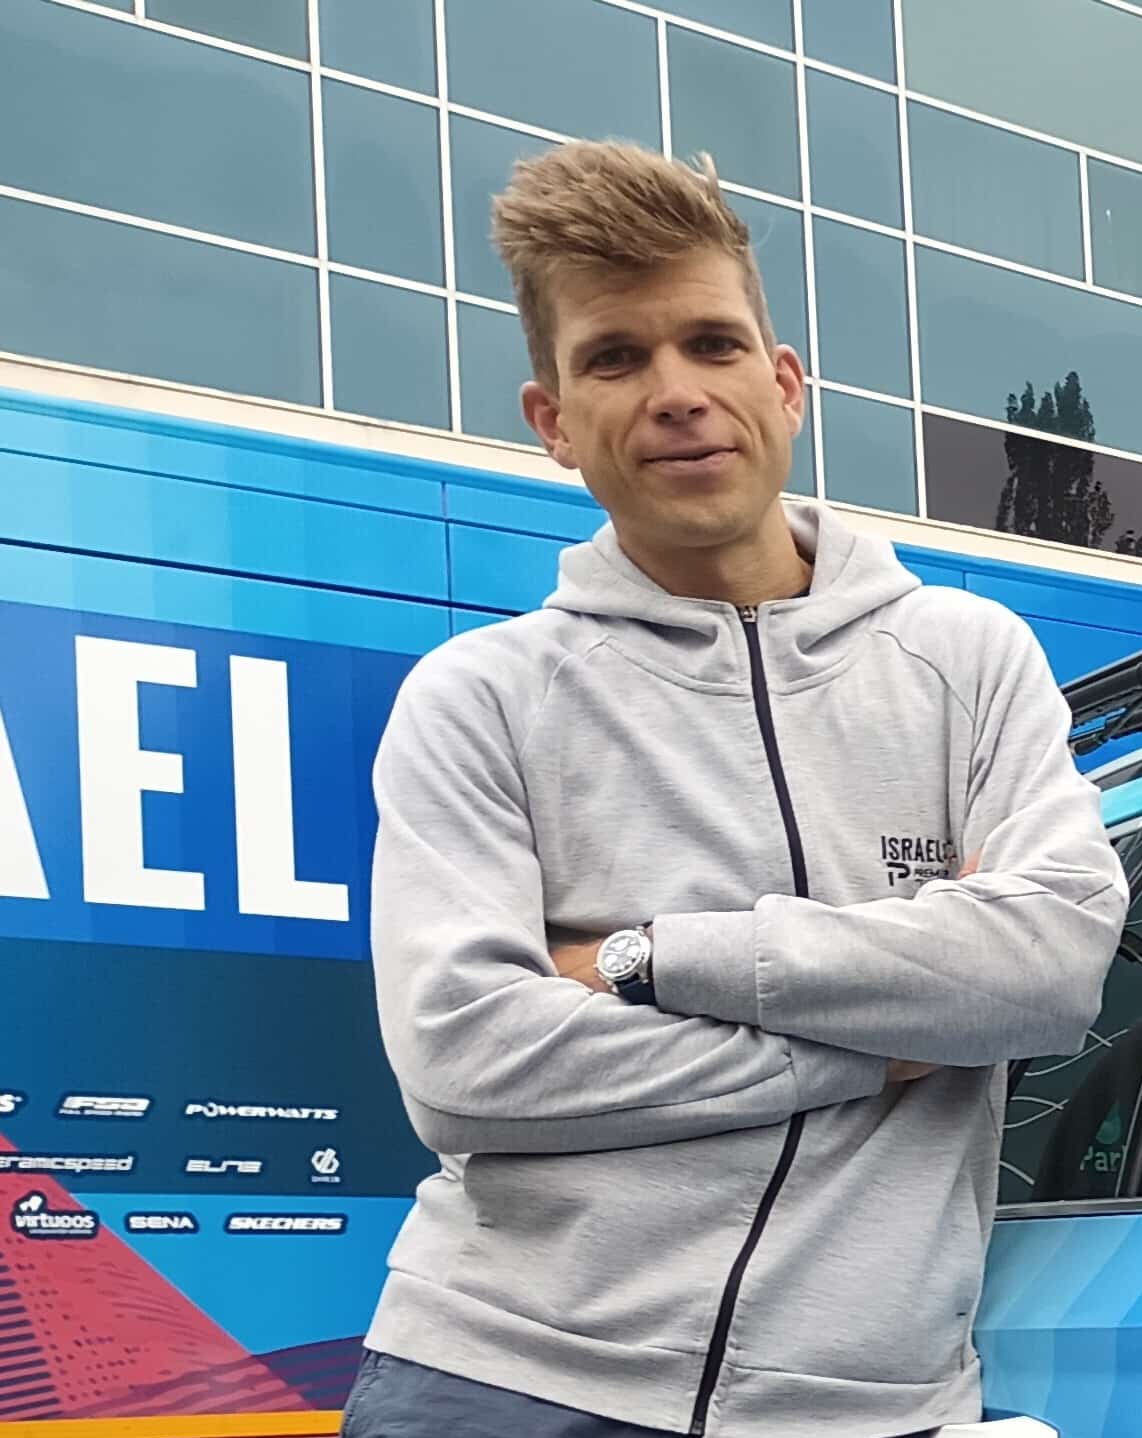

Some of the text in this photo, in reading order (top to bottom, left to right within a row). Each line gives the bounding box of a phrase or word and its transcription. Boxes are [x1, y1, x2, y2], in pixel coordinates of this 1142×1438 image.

[881, 835, 944, 863] ISRAEL
[129, 1216, 194, 1229] SENA
[228, 1217, 343, 1230] SKECHERS
